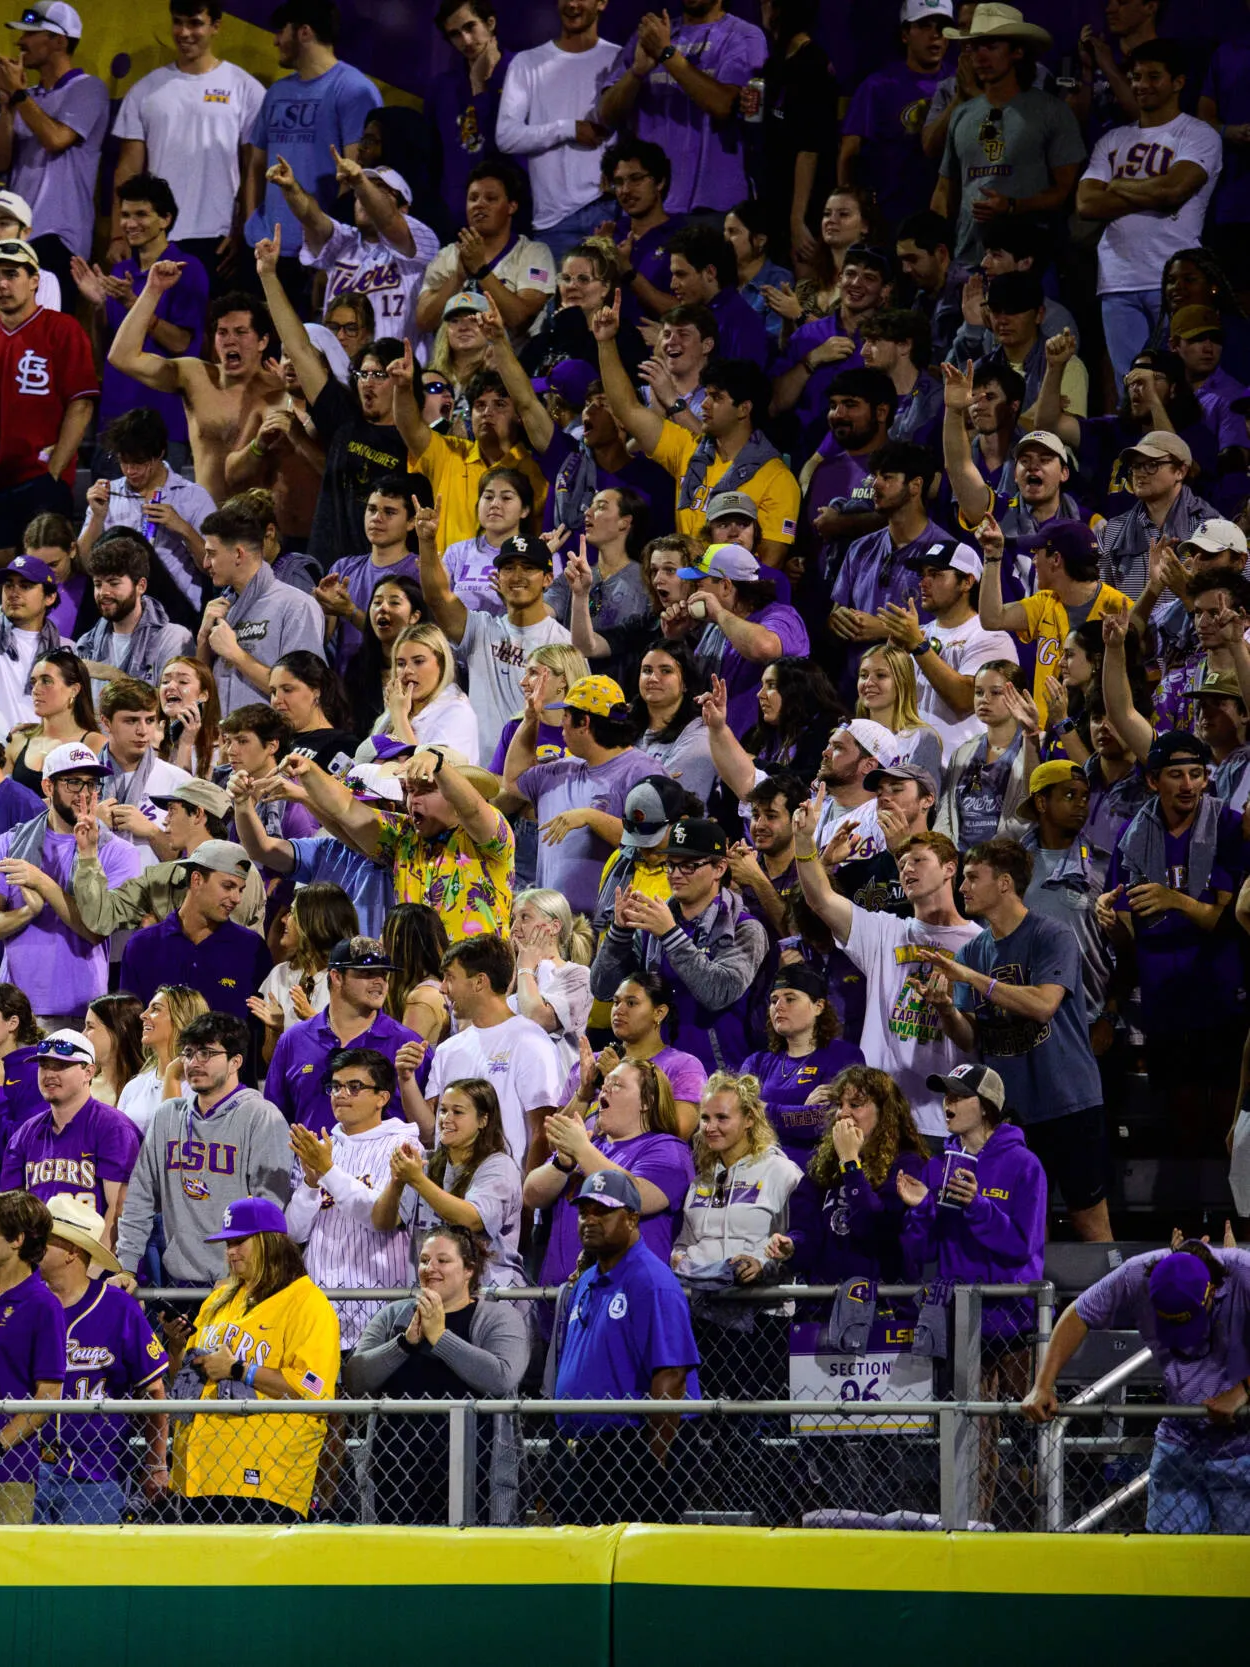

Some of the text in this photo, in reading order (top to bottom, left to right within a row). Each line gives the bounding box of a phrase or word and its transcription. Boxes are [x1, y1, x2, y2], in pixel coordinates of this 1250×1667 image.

[267, 103, 319, 130] LSU
[1109, 141, 1174, 178] LSU
[381, 295, 404, 318] 17
[69, 749, 95, 762] Tigers
[892, 1006, 940, 1027] CAPTAIN
[165, 1140, 238, 1176] LSU
[25, 1159, 95, 1190] TIGERS
[981, 1187, 1009, 1201] LSU
[66, 1338, 114, 1370] Rouge
[829, 1361, 891, 1377] SECTION
[75, 1376, 107, 1401] 14
